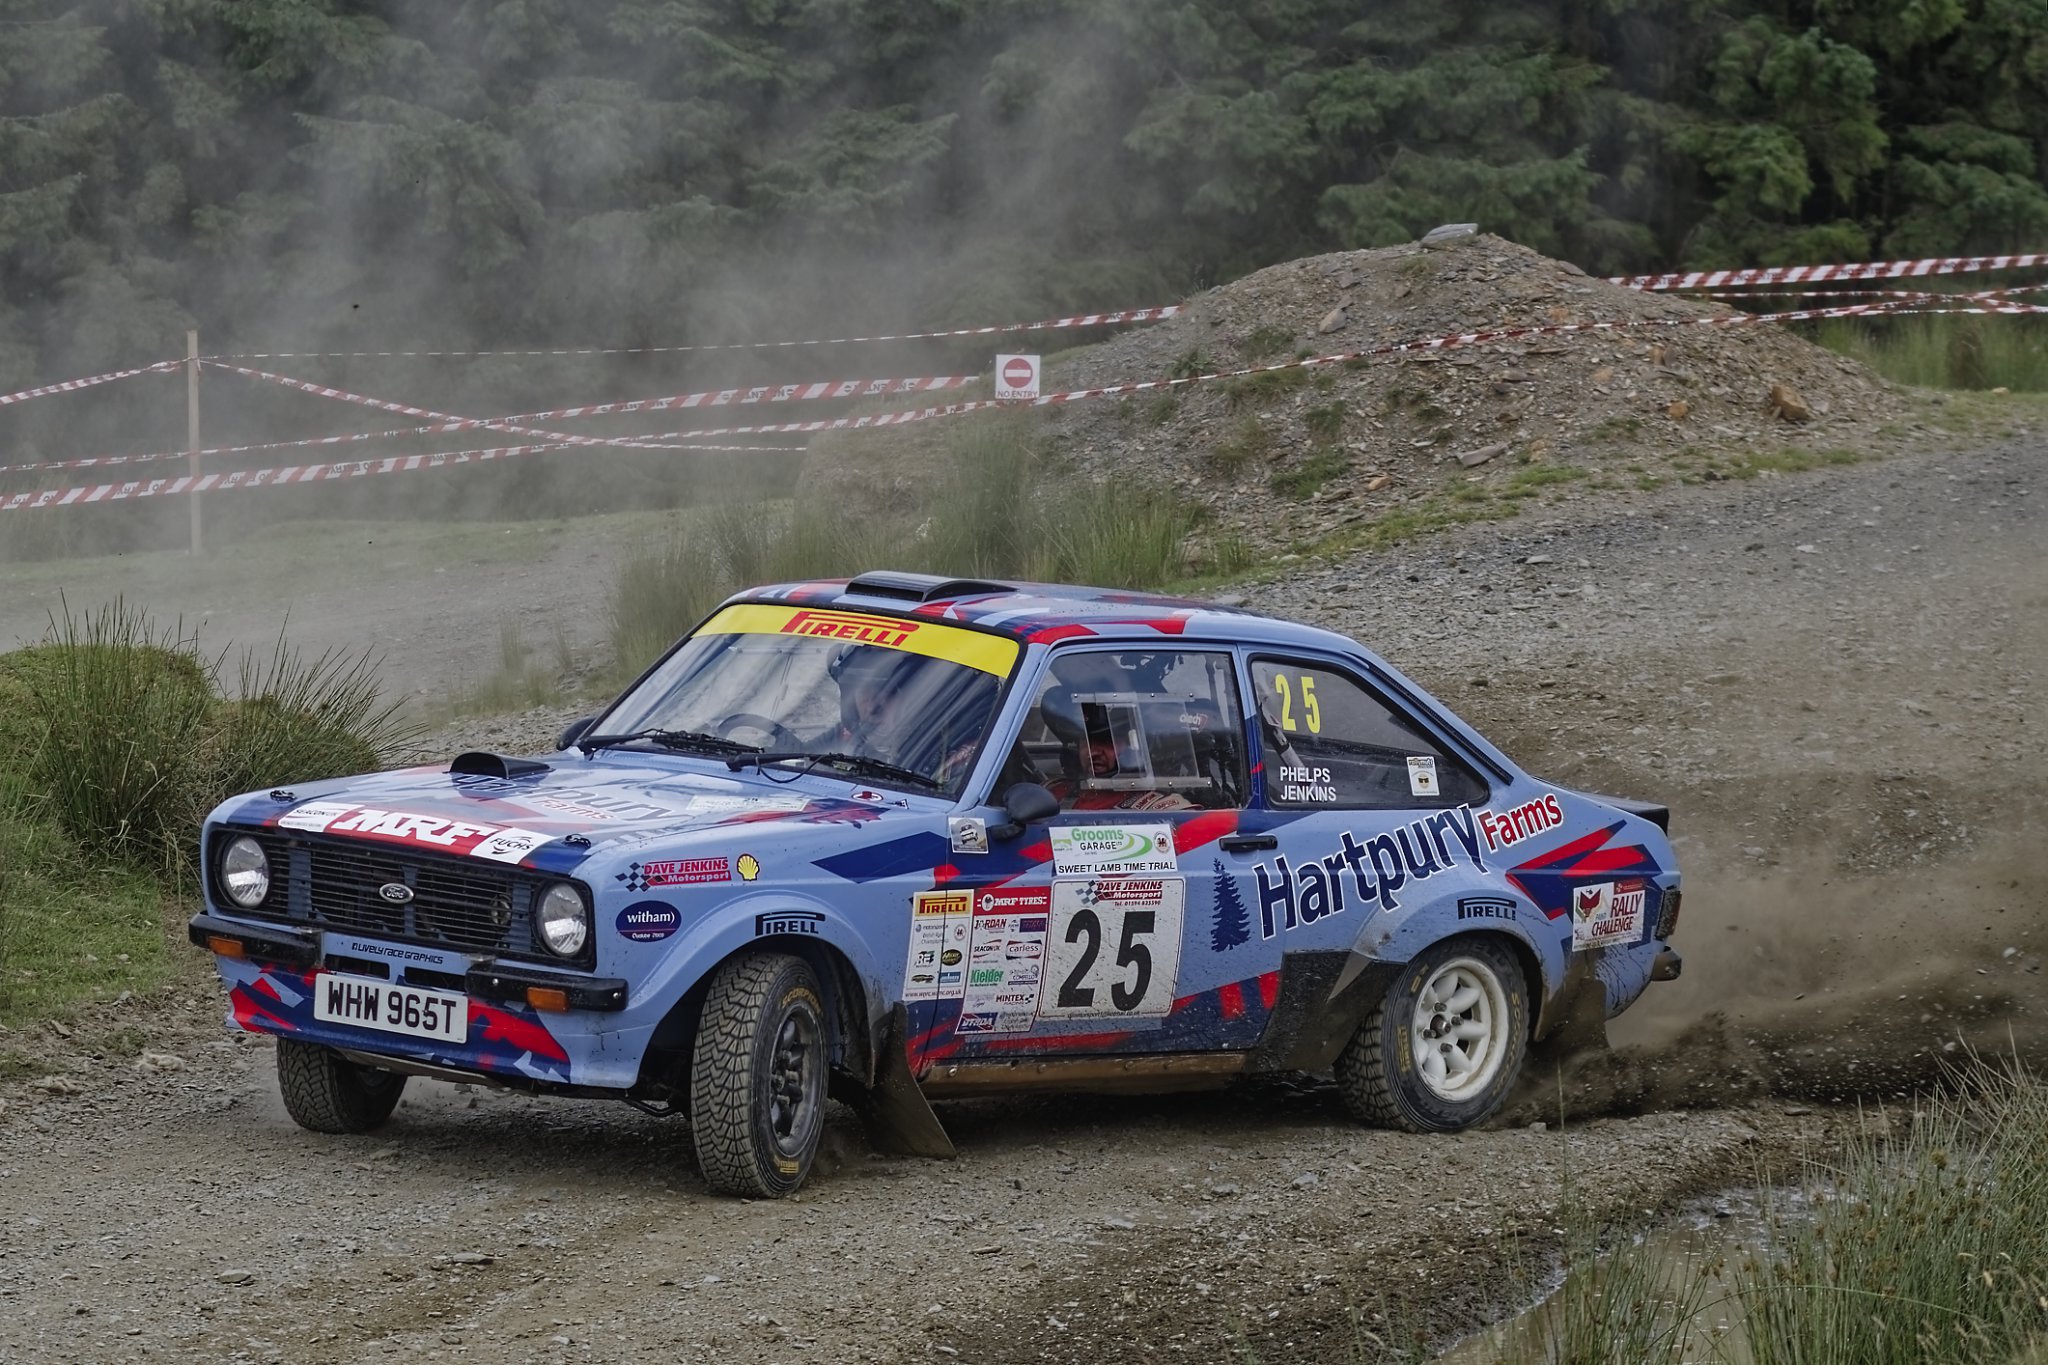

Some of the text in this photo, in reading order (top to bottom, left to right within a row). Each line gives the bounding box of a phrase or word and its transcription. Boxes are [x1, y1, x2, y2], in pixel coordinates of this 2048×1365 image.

[780, 610, 920, 647] PIRELLI
[1275, 674, 1321, 733] 25
[1280, 766, 1331, 783] PHELPS
[1280, 785, 1337, 801] JENKINS
[331, 808, 499, 846] MRF
[1072, 828, 1124, 840] Grooms
[490, 838, 531, 851] FUCHS
[1080, 841, 1117, 851] GARAGE
[644, 858, 729, 874] DAVE JENKINS
[1058, 861, 1175, 873] SWEET LAMB TIME TRIAL
[1253, 793, 1564, 941] Hartpury Farms
[667, 871, 730, 883] Motorsport
[1097, 881, 1162, 891] DAVE JENKINS
[994, 896, 1043, 906] MRF TYRES
[1113, 891, 1161, 899] Motorsport
[919, 896, 967, 914] PIRELLI
[1458, 897, 1517, 921] PIRELLI
[1610, 893, 1643, 918] RALLY
[627, 910, 671, 923] witham
[1591, 915, 1634, 936] CHALLENGE
[1009, 945, 1039, 953] carless
[1057, 909, 1156, 1011] 25
[970, 968, 1004, 984] Kielder
[996, 994, 1025, 1002] MINTEX
[328, 981, 457, 1034] WHW 965T
